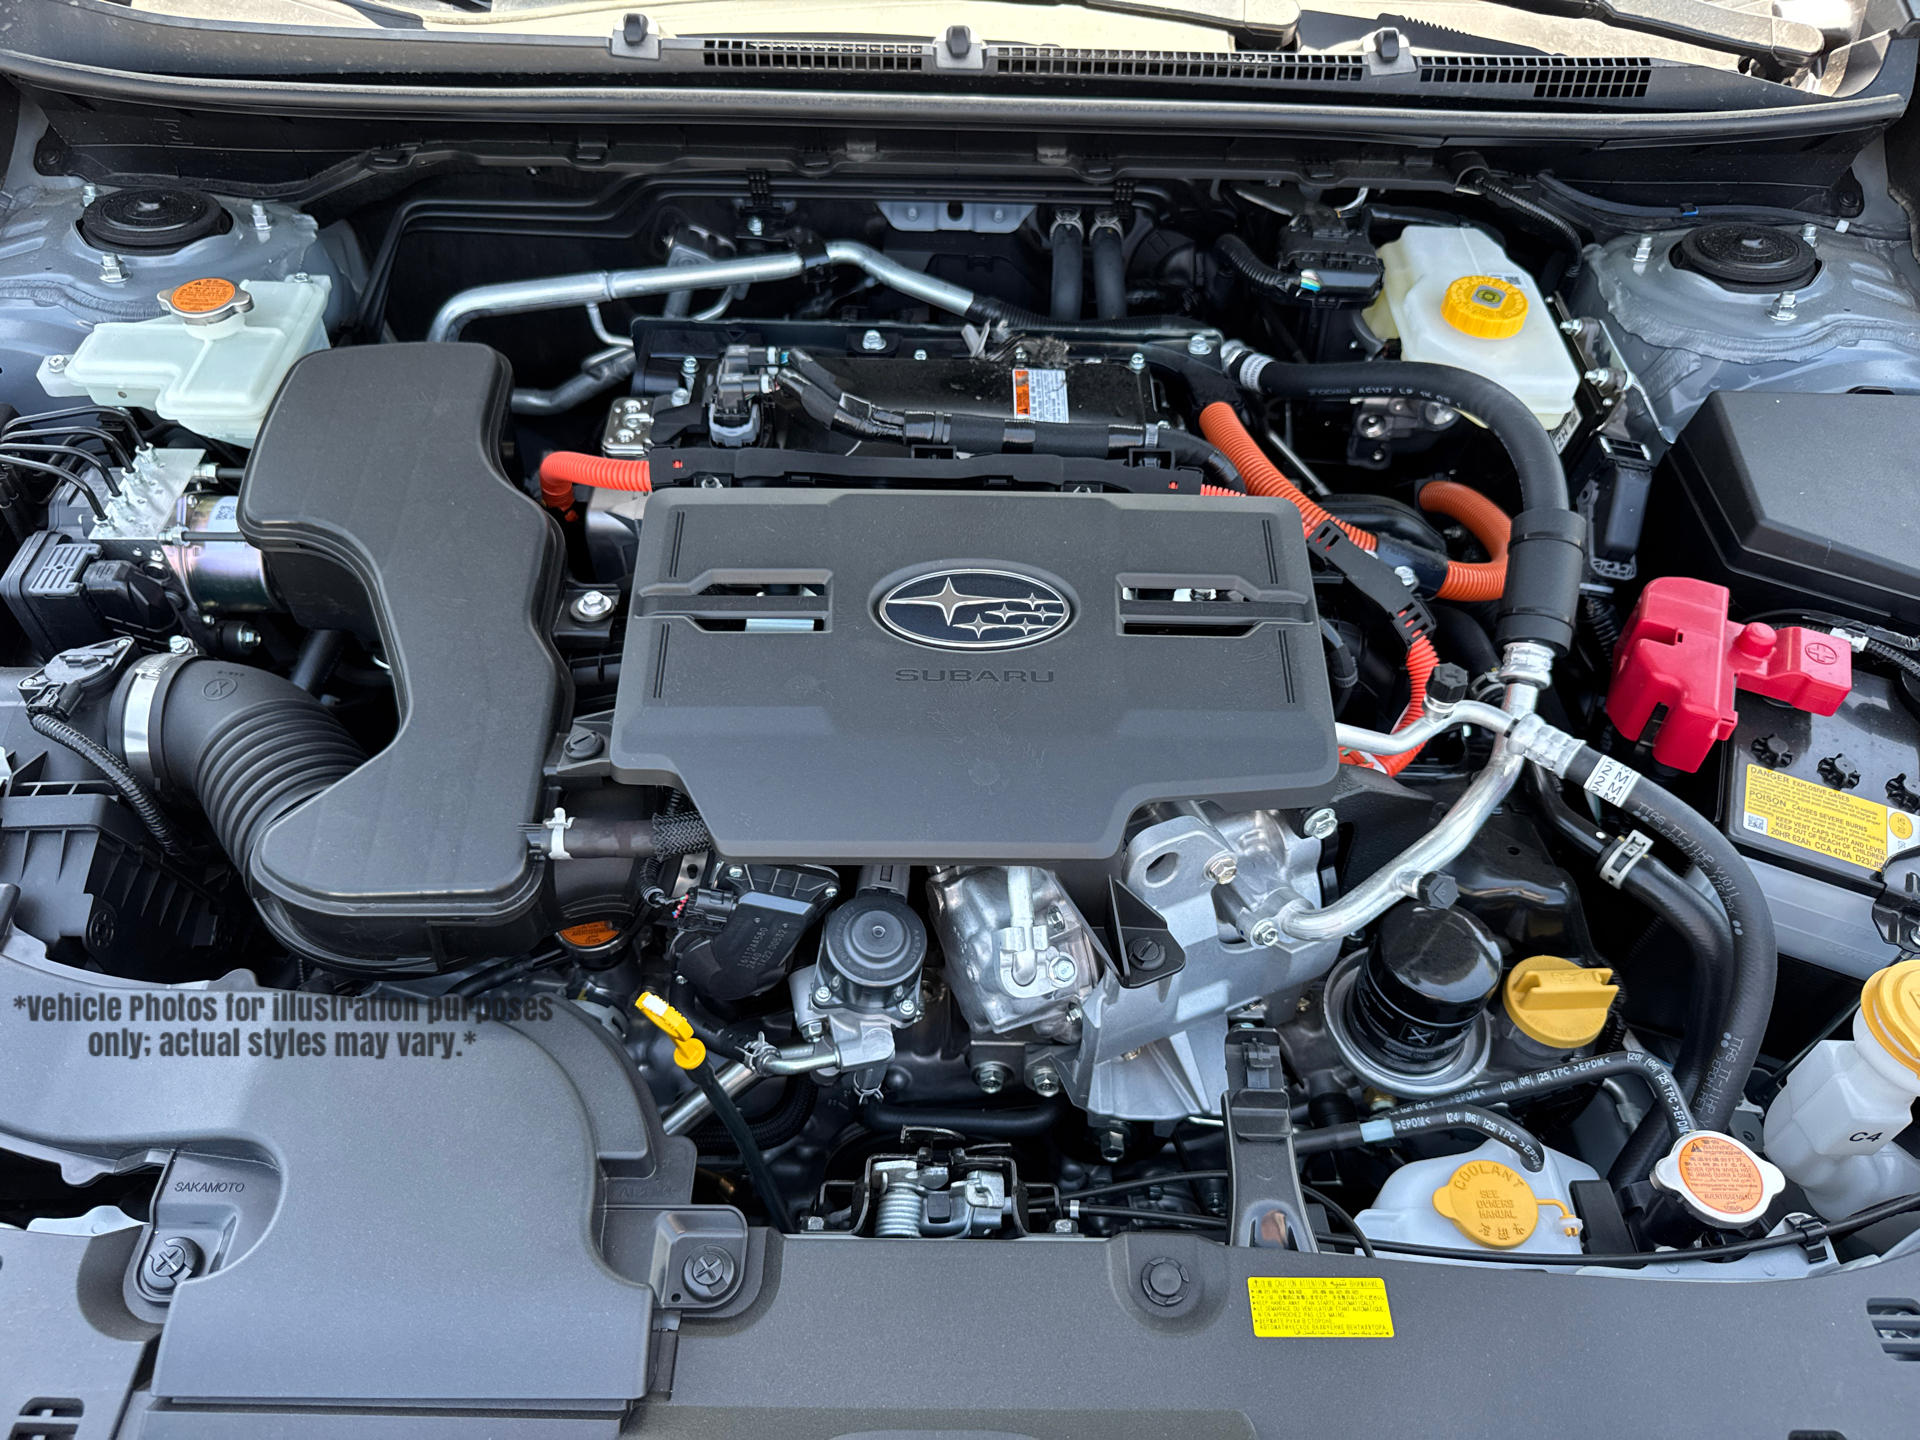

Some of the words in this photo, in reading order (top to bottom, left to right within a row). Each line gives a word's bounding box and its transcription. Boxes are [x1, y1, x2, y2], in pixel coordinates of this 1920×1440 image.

[895, 669, 1054, 683] SUBARU
[1594, 776, 1606, 787] 2
[1607, 782, 1623, 796] M
[1601, 765, 1612, 776] 2
[1614, 771, 1629, 785] M
[1749, 766, 1791, 784] DANGER
[1792, 780, 1827, 795] EXPLOSIVE
[1828, 791, 1850, 802] GASES
[1638, 802, 1666, 826] TTAS
[1748, 790, 1787, 807] POISON
[1791, 804, 1818, 817] CAUSES
[1818, 812, 1844, 825] SEVERE
[1845, 821, 1868, 833] BURNS
[1770, 827, 1791, 840] 20HR
[1791, 834, 1812, 846] 62Ah
[1814, 841, 1833, 853] CCA
[1833, 847, 1853, 860] 470A
[1775, 816, 1793, 825] KEEP
[1793, 821, 1811, 831] VENT
[1811, 827, 1830, 837] CAPS
[1831, 833, 1850, 843] TIGHT
[1850, 840, 1865, 848] AND
[1865, 844, 1886, 856] LEVEL
[1775, 822, 1792, 831] KEEP
[1793, 827, 1807, 836] OUT
[1818, 835, 1842, 847] REACH
[1852, 846, 1886, 861] CHILDREN
[1825, 943, 1883, 965] LOWER
[1551, 1066, 1570, 1078] TPC
[1573, 1056, 1611, 1072] >EPDM<
[1663, 1085, 1678, 1104] TPC
[1395, 1116, 1432, 1130] >EPDM<
[1499, 1126, 1518, 1144] TPC
[1849, 1132, 1883, 1142] C4
[174, 1182, 245, 1193] SAKAMOTO
[1454, 1163, 1524, 1190] COOLANT
[1476, 1200, 1515, 1209] OWNERS
[1480, 1189, 1499, 1199] SEE
[1479, 1209, 1517, 1219] MANUAL
